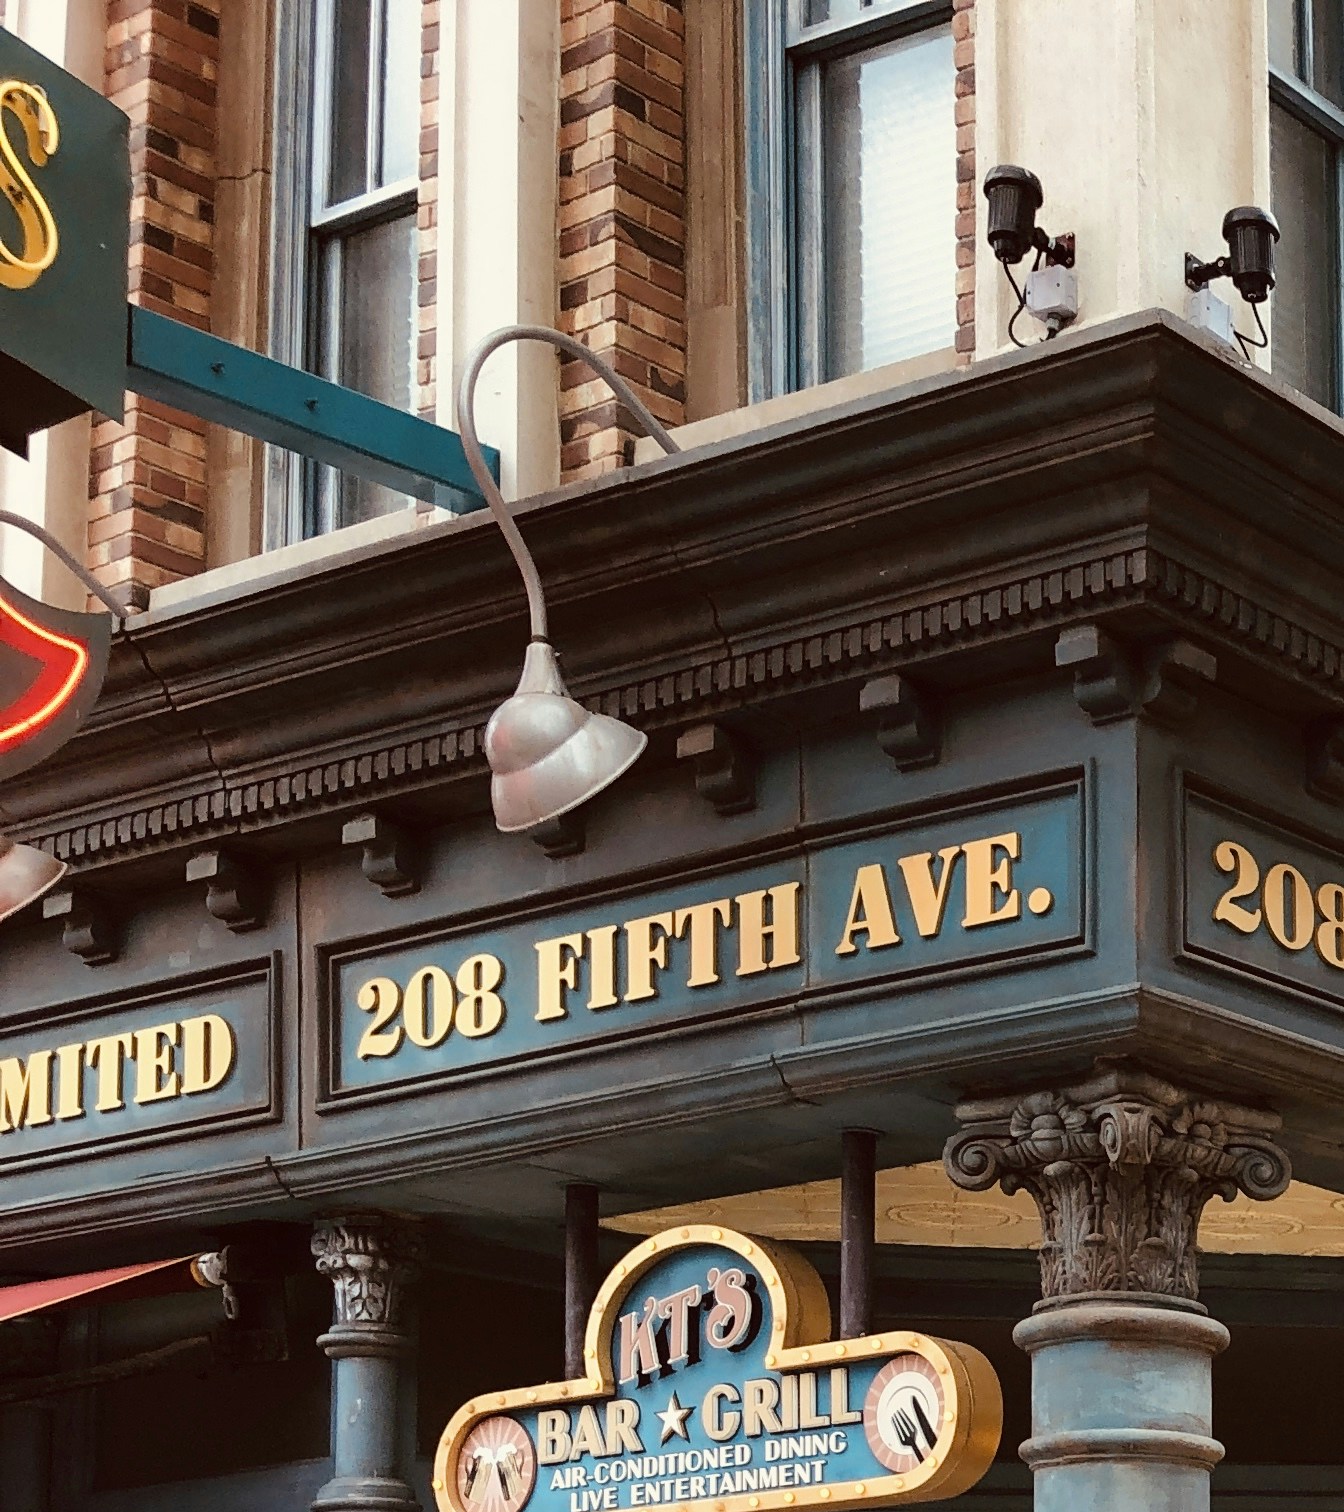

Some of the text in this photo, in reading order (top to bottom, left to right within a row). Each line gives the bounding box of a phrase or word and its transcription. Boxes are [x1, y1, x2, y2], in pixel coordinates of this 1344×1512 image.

[356, 831, 1054, 1061] 208 FIFTH AVE.
[0, 1013, 235, 1133] MITED
[618, 1266, 754, 1386] KT'S
[536, 1368, 863, 1467] BAR GRILL
[549, 1431, 848, 1491] AIR-CONDITIONED DINING
[570, 1461, 827, 1512] LIVE ENTERTAINMENT
